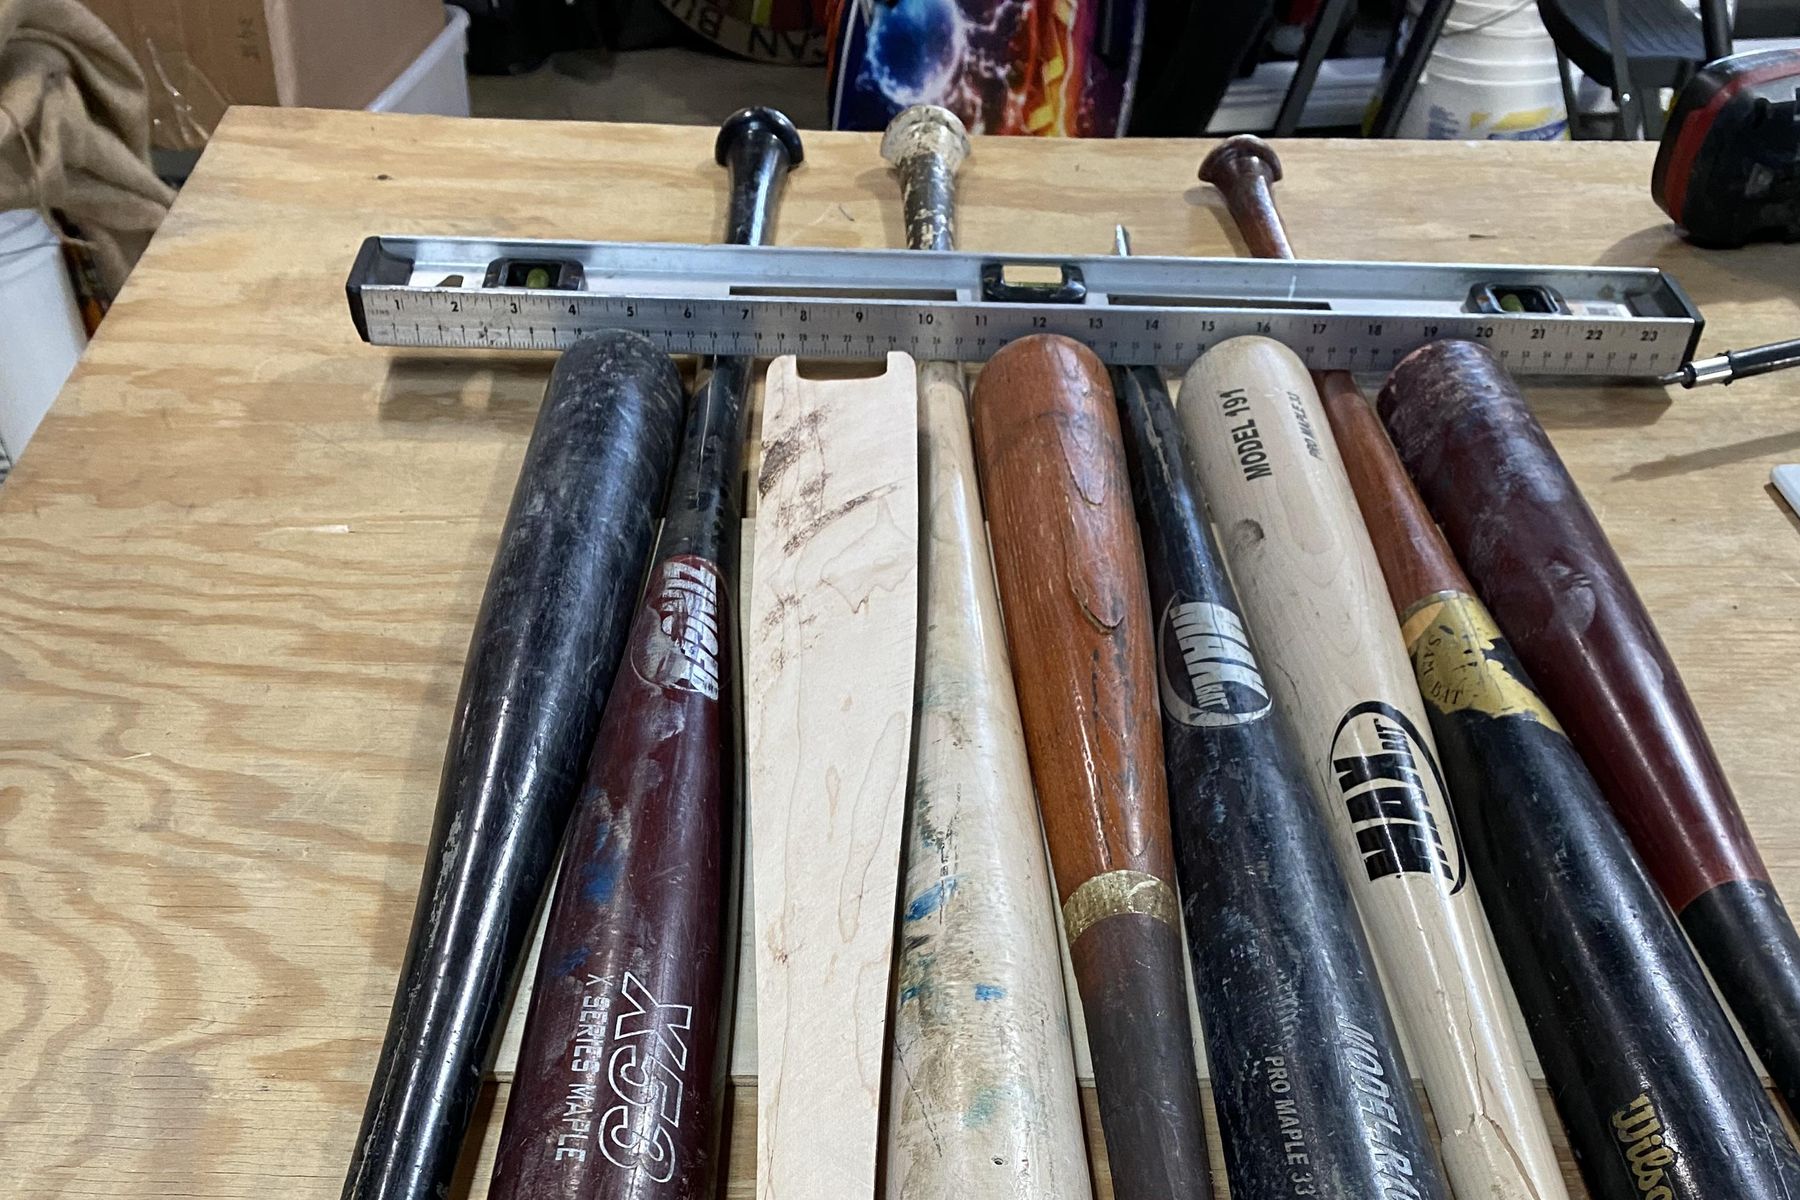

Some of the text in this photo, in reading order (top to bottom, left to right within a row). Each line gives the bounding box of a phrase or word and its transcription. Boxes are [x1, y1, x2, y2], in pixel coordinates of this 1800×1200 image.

[394, 299, 1658, 342] 1 2 3 4 5 6 7 8 9 10 11 12 13 14 15 16 17 18 19 20 21 22 23
[1219, 388, 1273, 482] MODEL 191
[1422, 634, 1464, 705] SAM BAT
[554, 973, 615, 1163] X SERIES MAPLE
[598, 971, 693, 1183] X53
[1264, 1055, 1291, 1093] PRO
[1336, 1015, 1402, 1137] MODEL
[1274, 1099, 1310, 1167] MAPLE
[1290, 1171, 1317, 1197] 33
